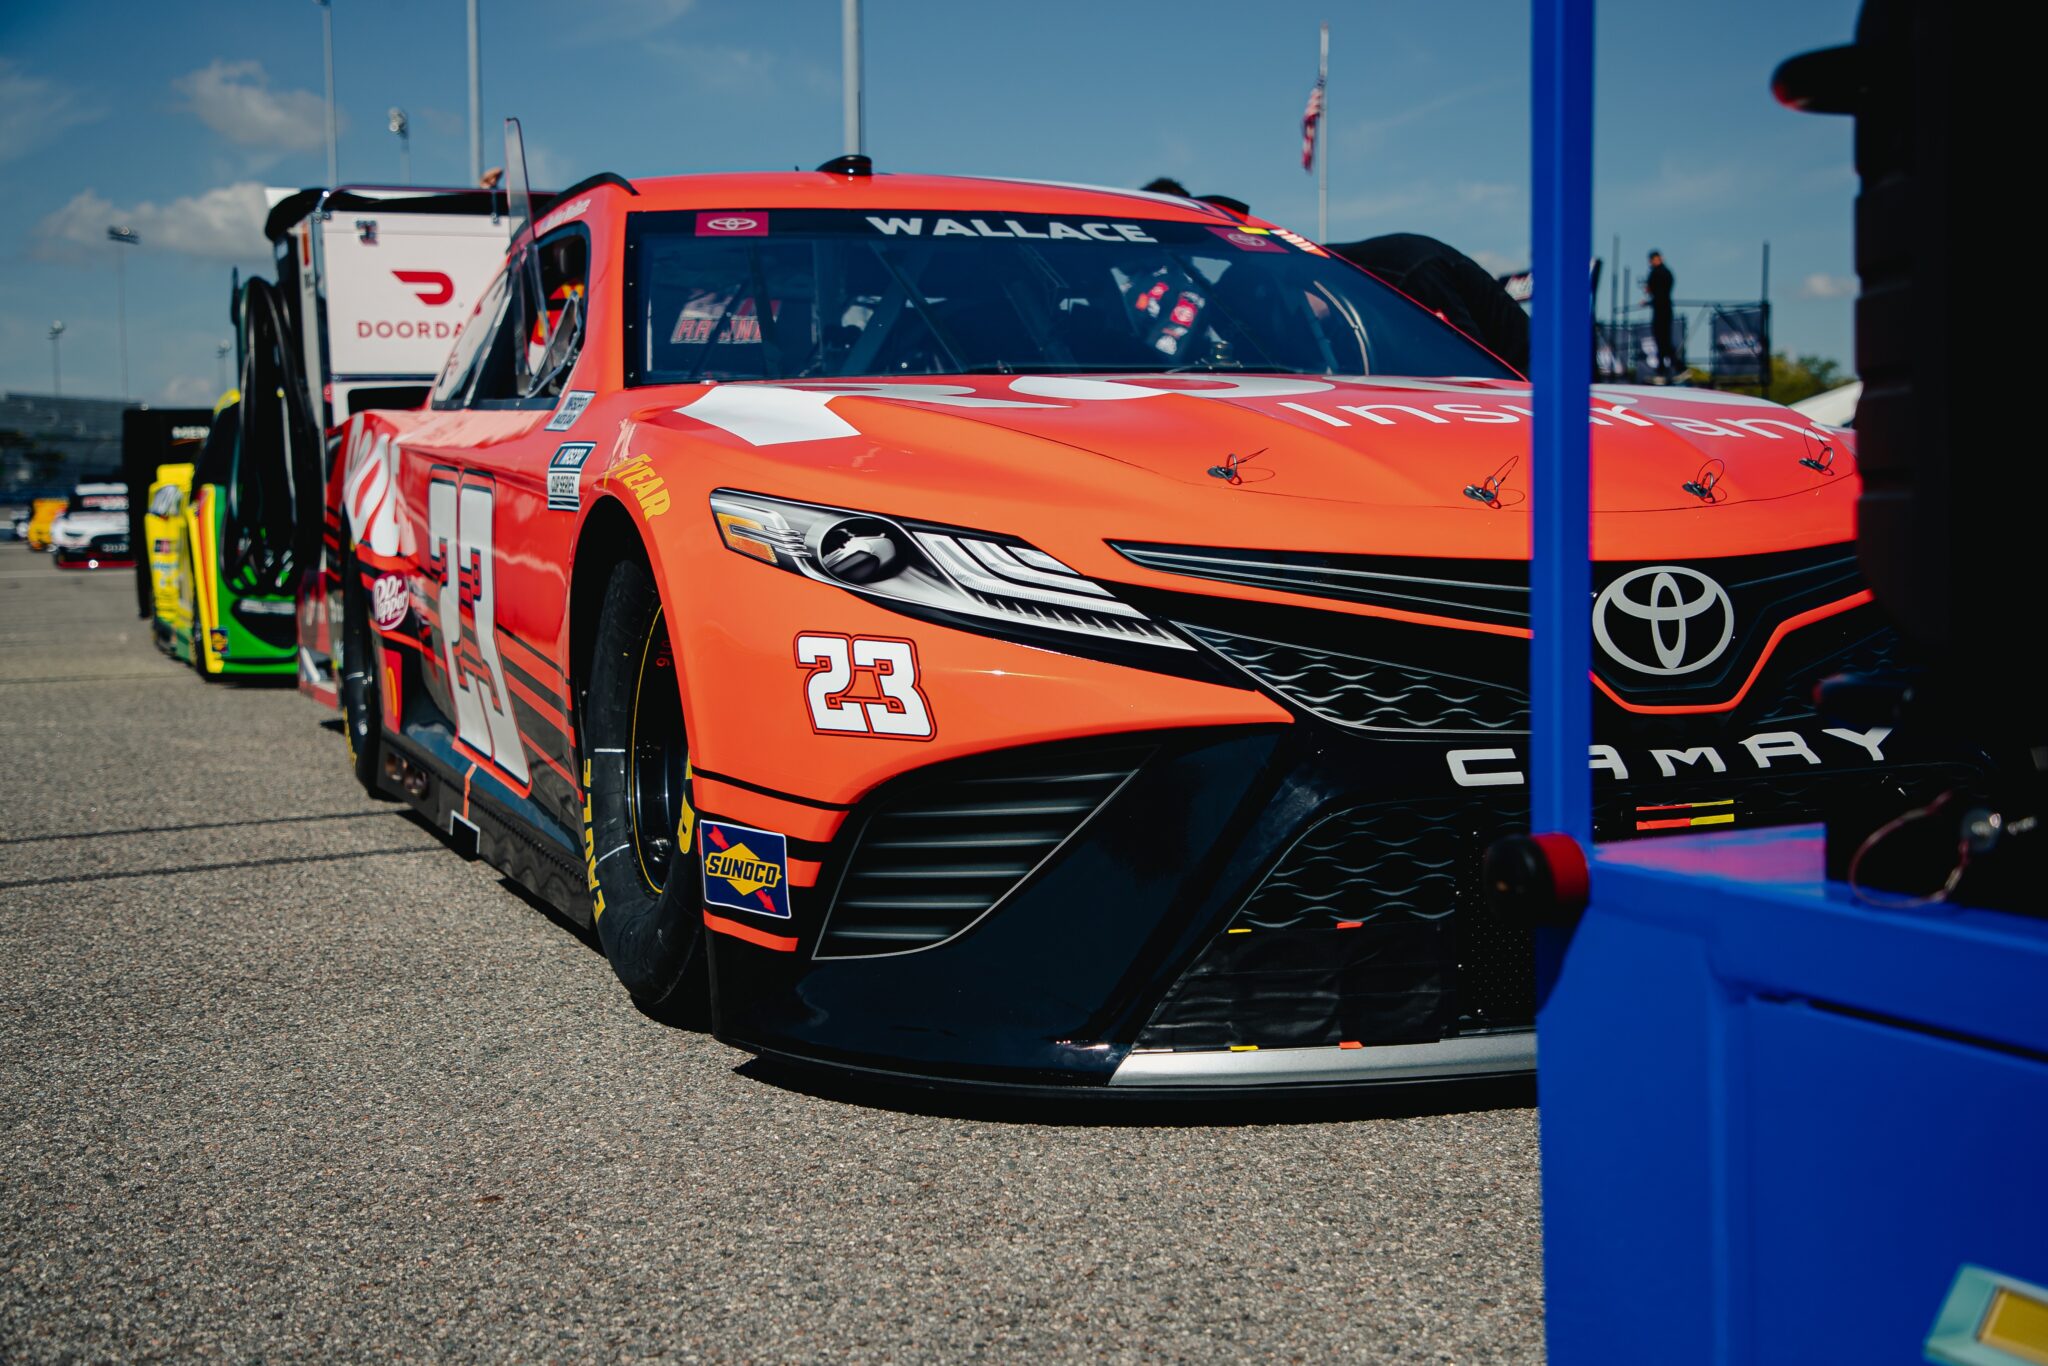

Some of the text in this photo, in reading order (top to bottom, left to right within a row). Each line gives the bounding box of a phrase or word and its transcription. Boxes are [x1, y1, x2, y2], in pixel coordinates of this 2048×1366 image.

[865, 216, 1158, 243] WALLACE
[357, 320, 464, 339] DOORDA
[428, 470, 532, 790] 23
[796, 634, 935, 739] 23
[708, 855, 778, 885] SUNOCO
